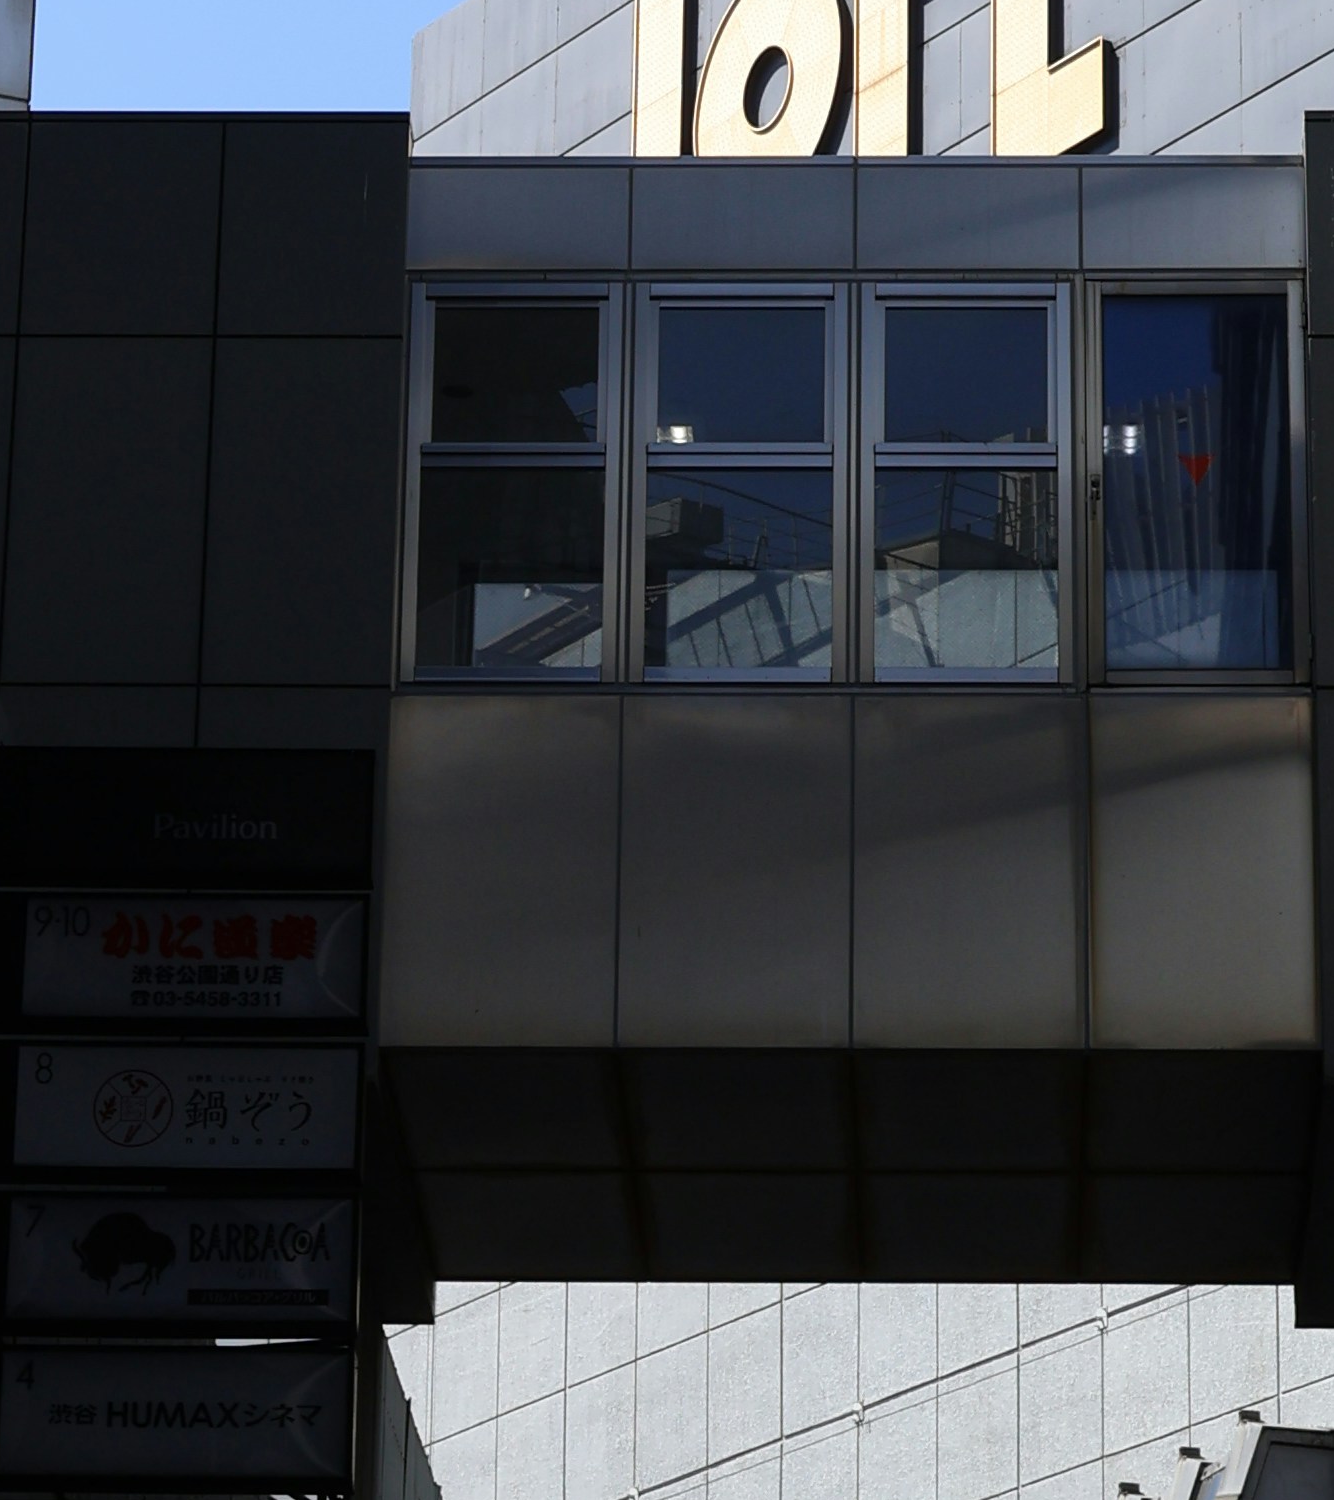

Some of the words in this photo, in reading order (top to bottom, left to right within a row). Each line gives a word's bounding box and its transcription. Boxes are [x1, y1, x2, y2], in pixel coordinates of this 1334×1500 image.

[153, 813, 279, 841] Pavilion
[131, 965, 285, 986] 渋谷公園通り店
[35, 1052, 53, 1084] 8
[185, 1088, 313, 1132] 鍋ぞう
[26, 1205, 45, 1237] 7
[188, 1222, 331, 1262] BARBACOA
[16, 1360, 35, 1390] 4
[48, 1404, 97, 1425] 渋谷
